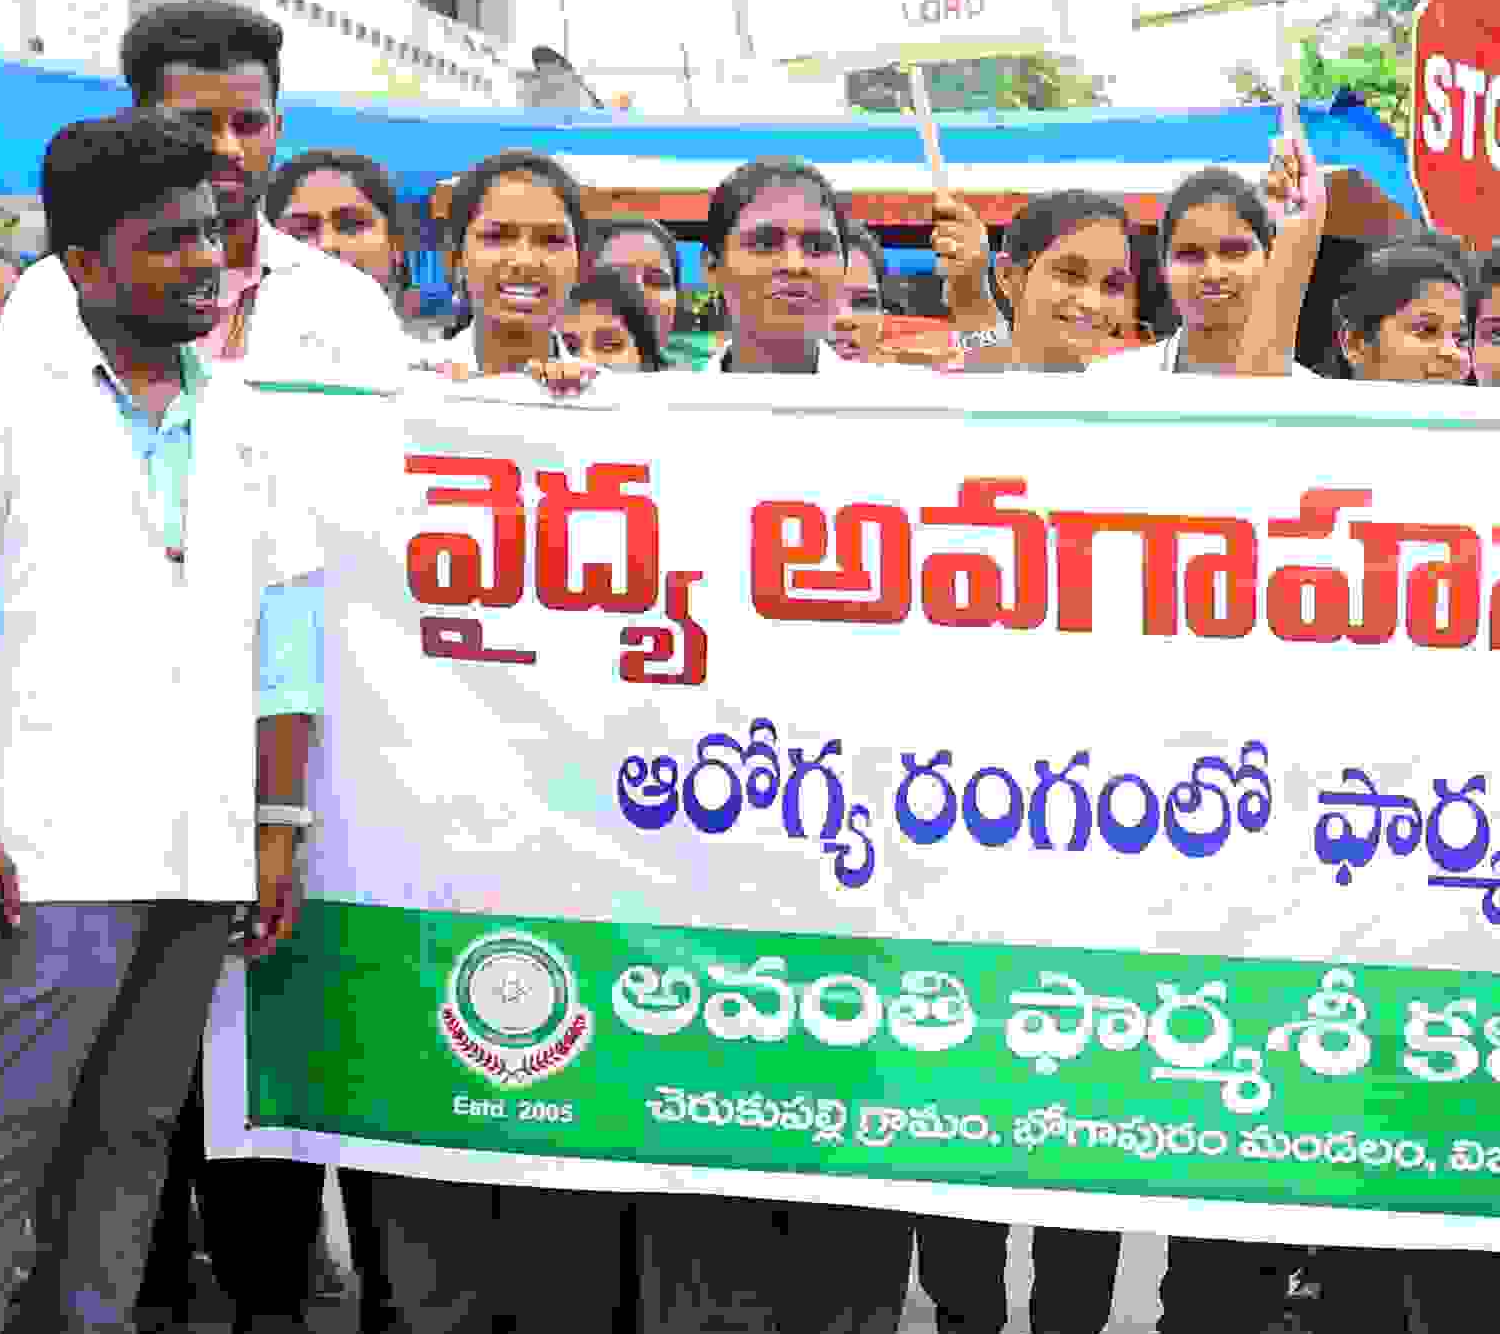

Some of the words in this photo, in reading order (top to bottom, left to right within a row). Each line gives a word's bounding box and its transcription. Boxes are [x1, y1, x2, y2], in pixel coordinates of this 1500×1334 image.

[403, 454, 709, 685] వైద్య
[618, 717, 876, 890] ఆరోగ్య
[894, 738, 1272, 859] రంగంలో
[611, 955, 977, 1052] అవంతి
[1004, 966, 1373, 1115] ఫార్మశీ
[1012, 1100, 1229, 1161] భోగాపురం
